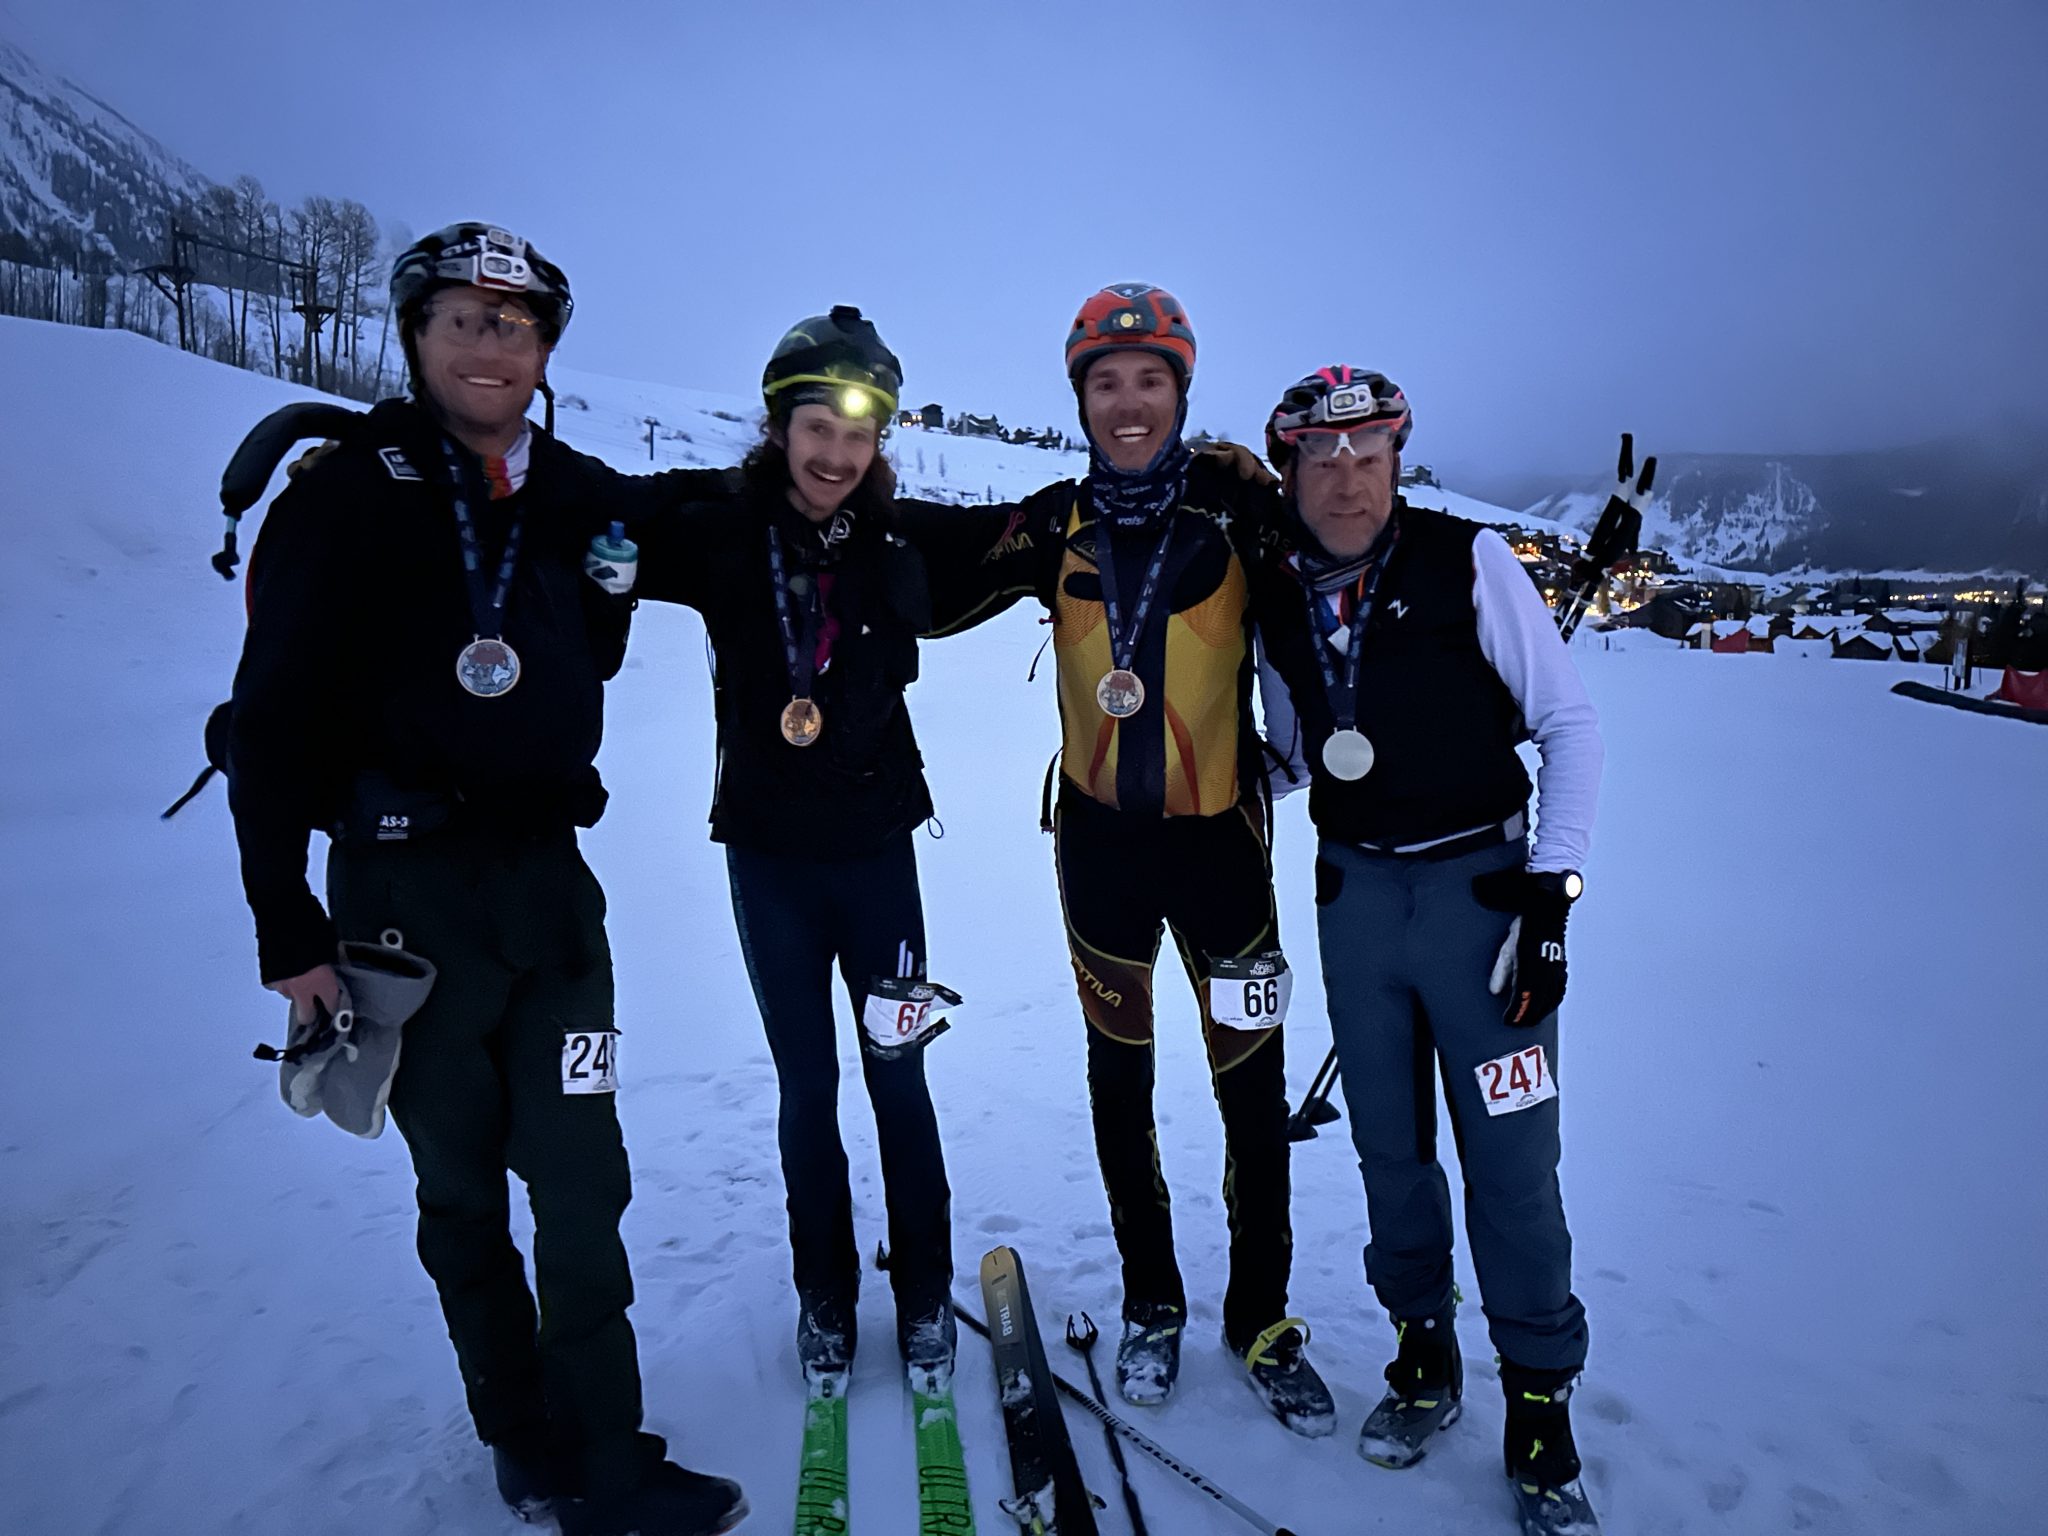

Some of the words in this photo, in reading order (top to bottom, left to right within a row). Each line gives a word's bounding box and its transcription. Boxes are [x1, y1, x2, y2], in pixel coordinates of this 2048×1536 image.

[379, 815, 410, 828] AS-3
[1244, 979, 1278, 1018] 66
[1482, 1047, 1543, 1101] 247
